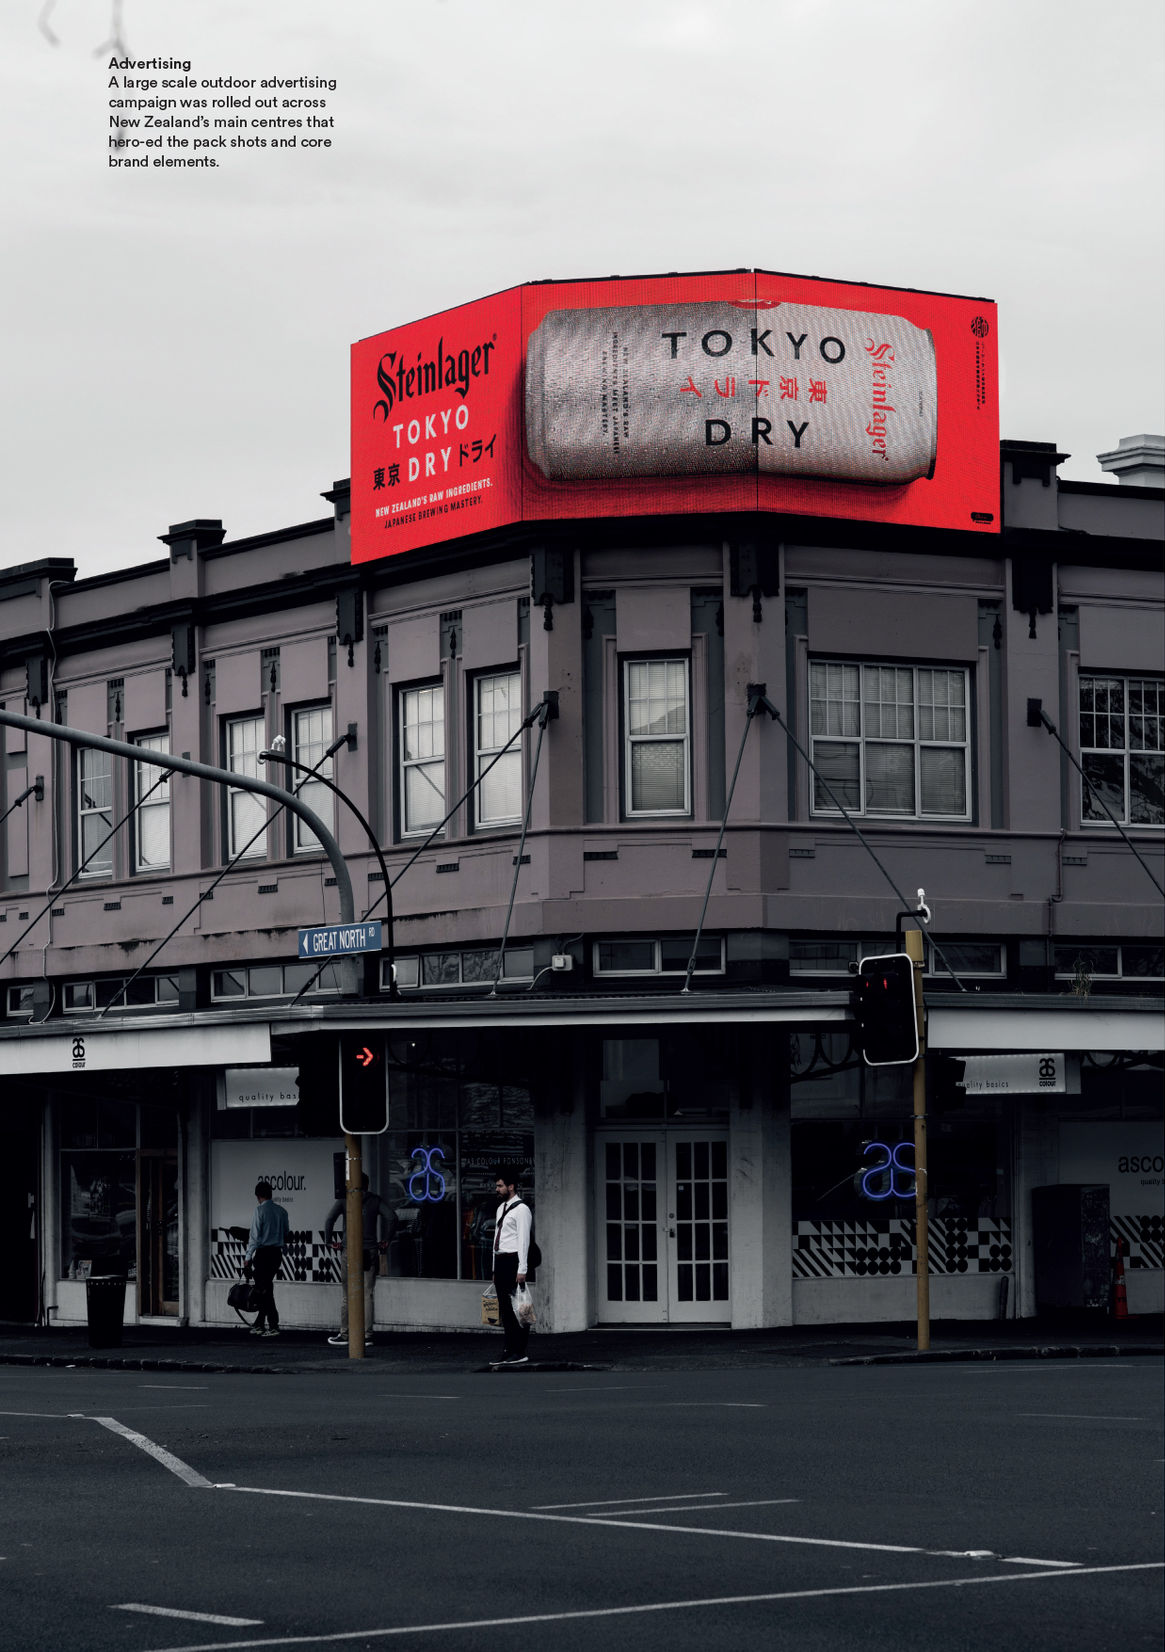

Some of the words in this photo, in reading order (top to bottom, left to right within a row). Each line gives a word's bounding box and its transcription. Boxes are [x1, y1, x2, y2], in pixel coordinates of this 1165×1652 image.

[662, 328, 846, 364] TOKYO
[373, 336, 495, 423] Steinlager
[393, 404, 469, 448] TOKYO
[705, 418, 810, 448] DRY
[409, 447, 452, 482] DRY
[459, 434, 496, 467] ドライ
[373, 463, 400, 491] 東京
[376, 505, 389, 518] NEW
[429, 490, 443, 503] RAW
[446, 478, 493, 499] INGREDIENTS.
[384, 512, 416, 529] JAPANESE
[418, 504, 449, 521] BREWING
[313, 931, 337, 953] GREAT
[340, 928, 366, 950] NORTH
[369, 926, 375, 937] RD
[239, 1091, 274, 1103] quality
[986, 1080, 1009, 1088] basics
